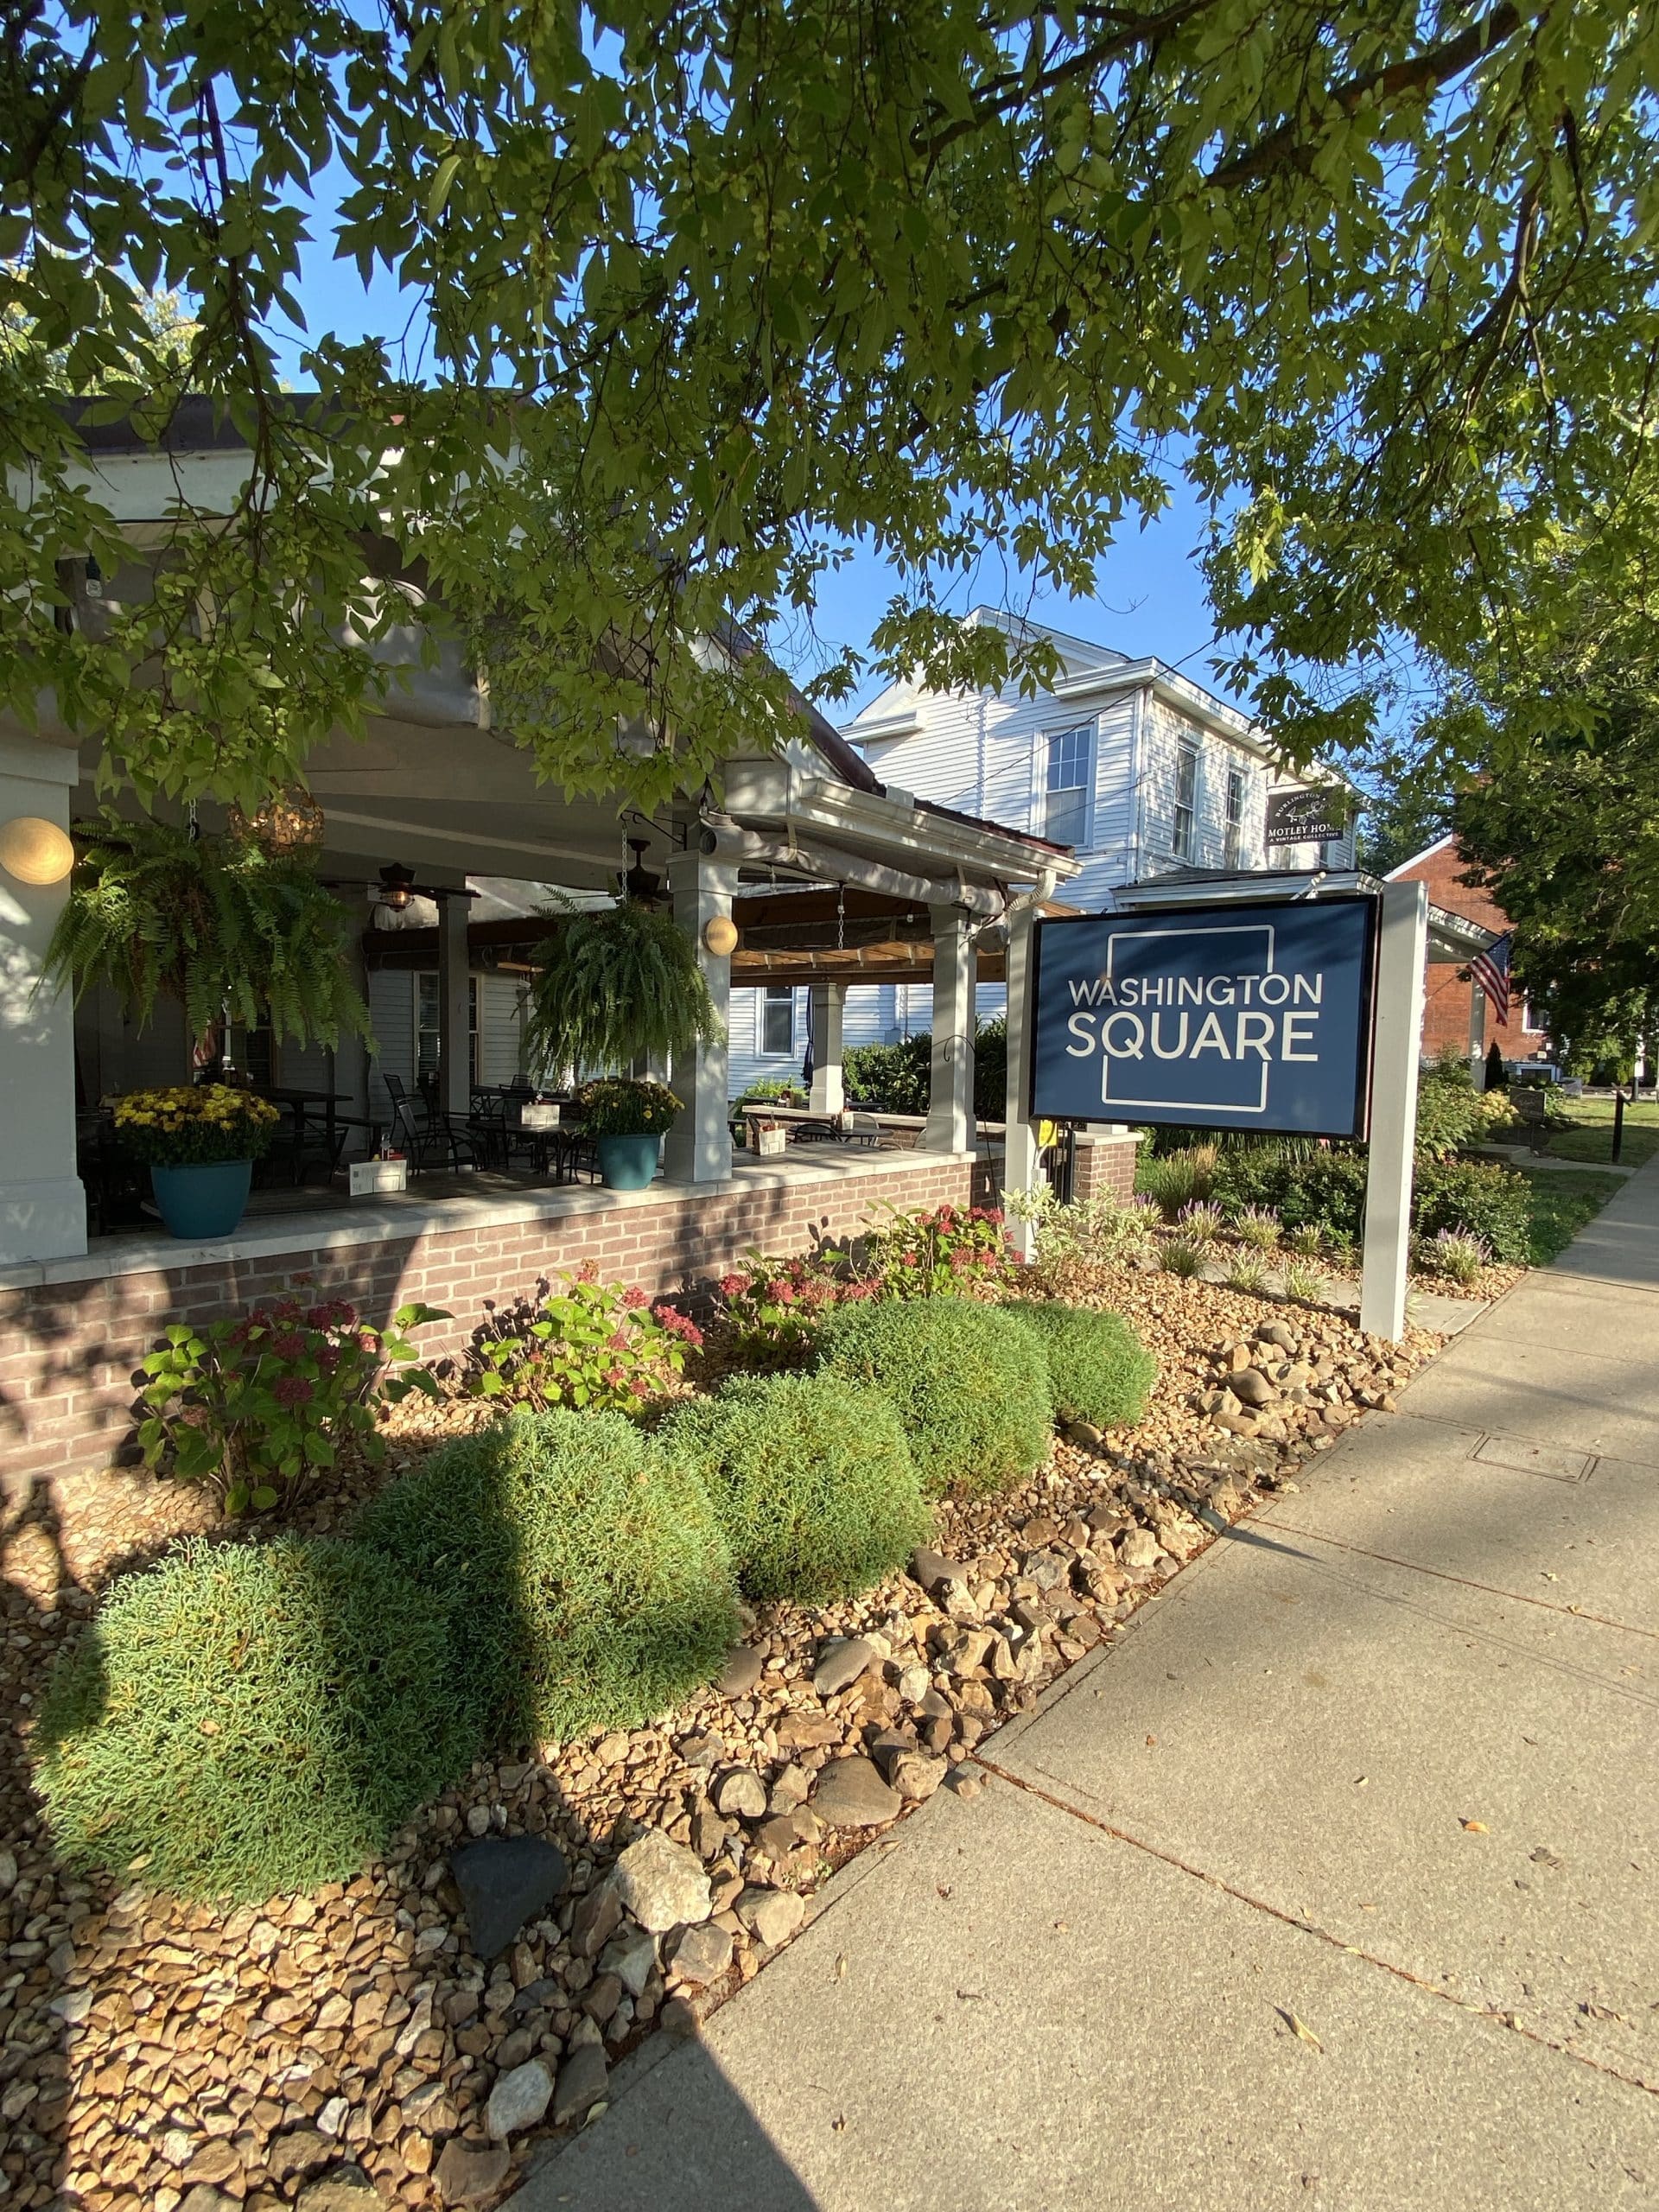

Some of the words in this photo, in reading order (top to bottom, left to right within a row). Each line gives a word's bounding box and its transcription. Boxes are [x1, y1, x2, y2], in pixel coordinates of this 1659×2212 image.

[1274, 792, 1321, 817] BURLINGTON
[1268, 825, 1308, 837] MOTLEY
[1067, 973, 1323, 1007] WASHINGTON
[1065, 1011, 1319, 1062] SQUARE
